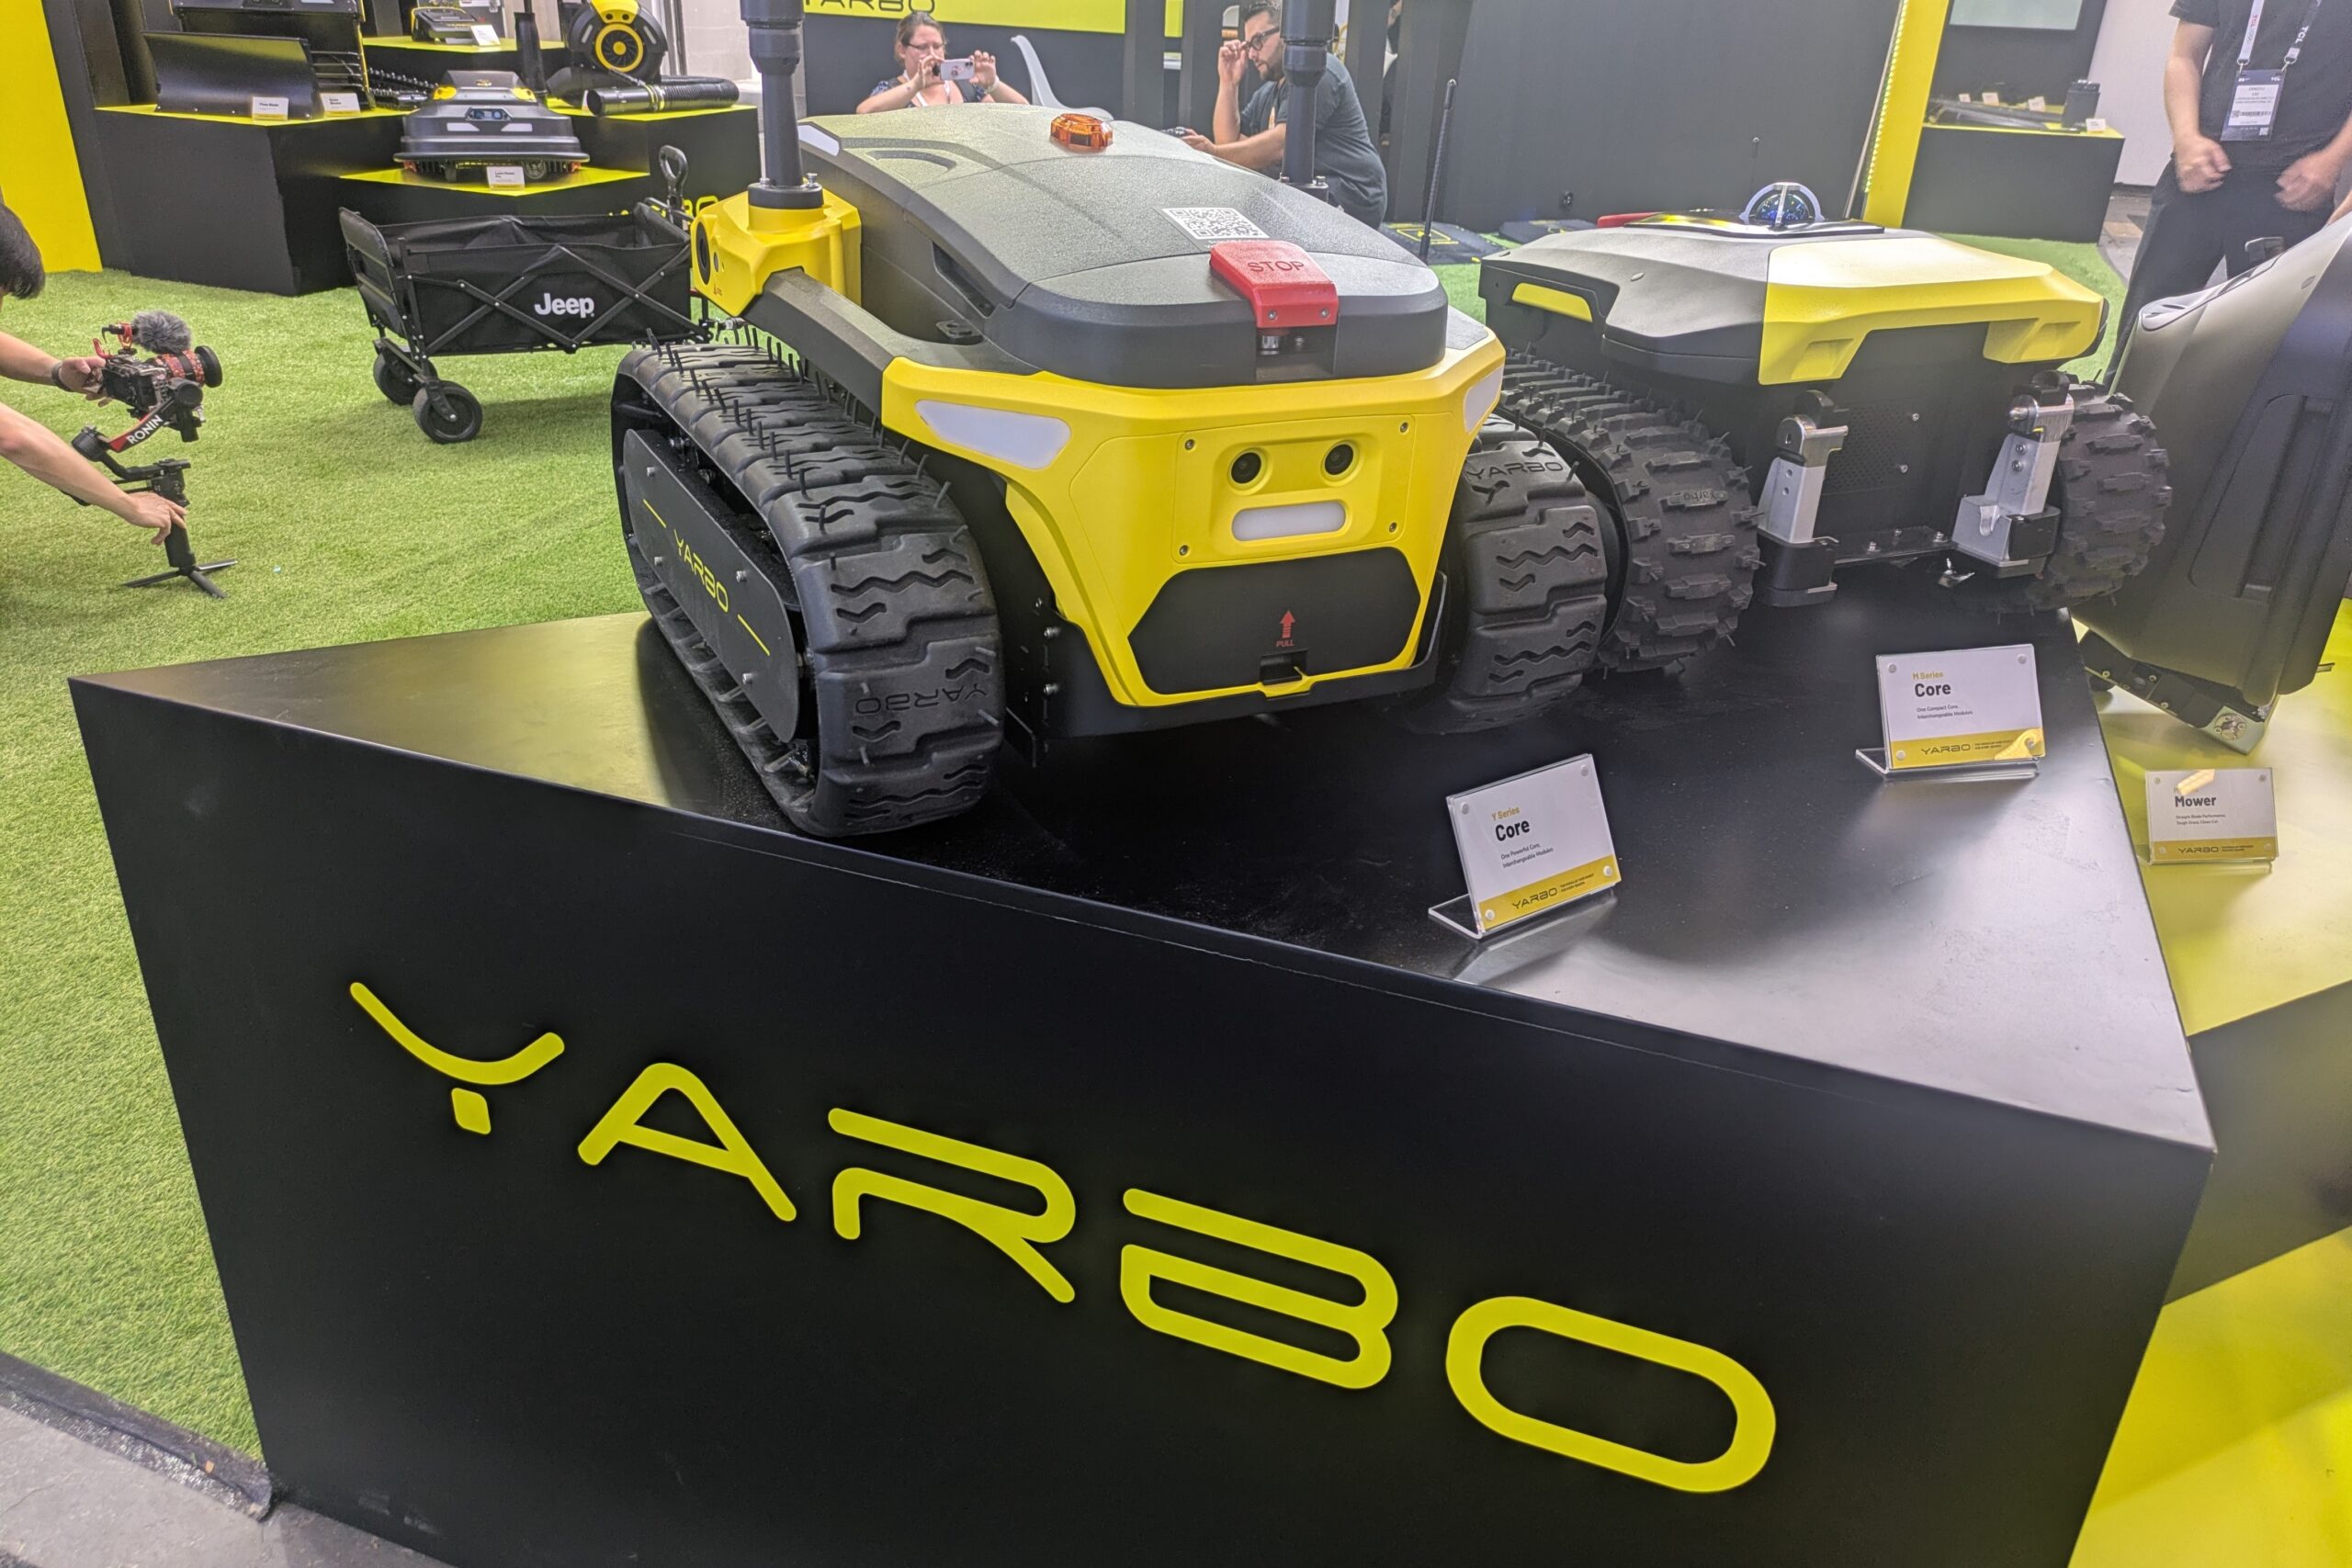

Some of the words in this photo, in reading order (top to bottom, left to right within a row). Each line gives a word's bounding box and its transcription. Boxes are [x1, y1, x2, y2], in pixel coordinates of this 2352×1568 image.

[2295, 26, 2309, 43] TCL
[1248, 260, 1305, 273] STOP
[534, 292, 594, 319] Jeep
[127, 414, 164, 445] RONIN
[1466, 461, 1564, 479] YARBO
[673, 528, 729, 613] YARBO
[1276, 639, 1295, 648] PULL
[1920, 671, 1943, 680] Series
[1915, 682, 1951, 697] Core
[855, 683, 987, 714] YARBO
[1921, 743, 1971, 755] YARBO
[2175, 795, 2217, 807] Mower
[1491, 812, 1497, 821] Y
[1498, 807, 1521, 819] Series
[1495, 820, 1530, 841] Core
[1512, 887, 1557, 909] YARBO
[349, 981, 1777, 1494] YARBO
